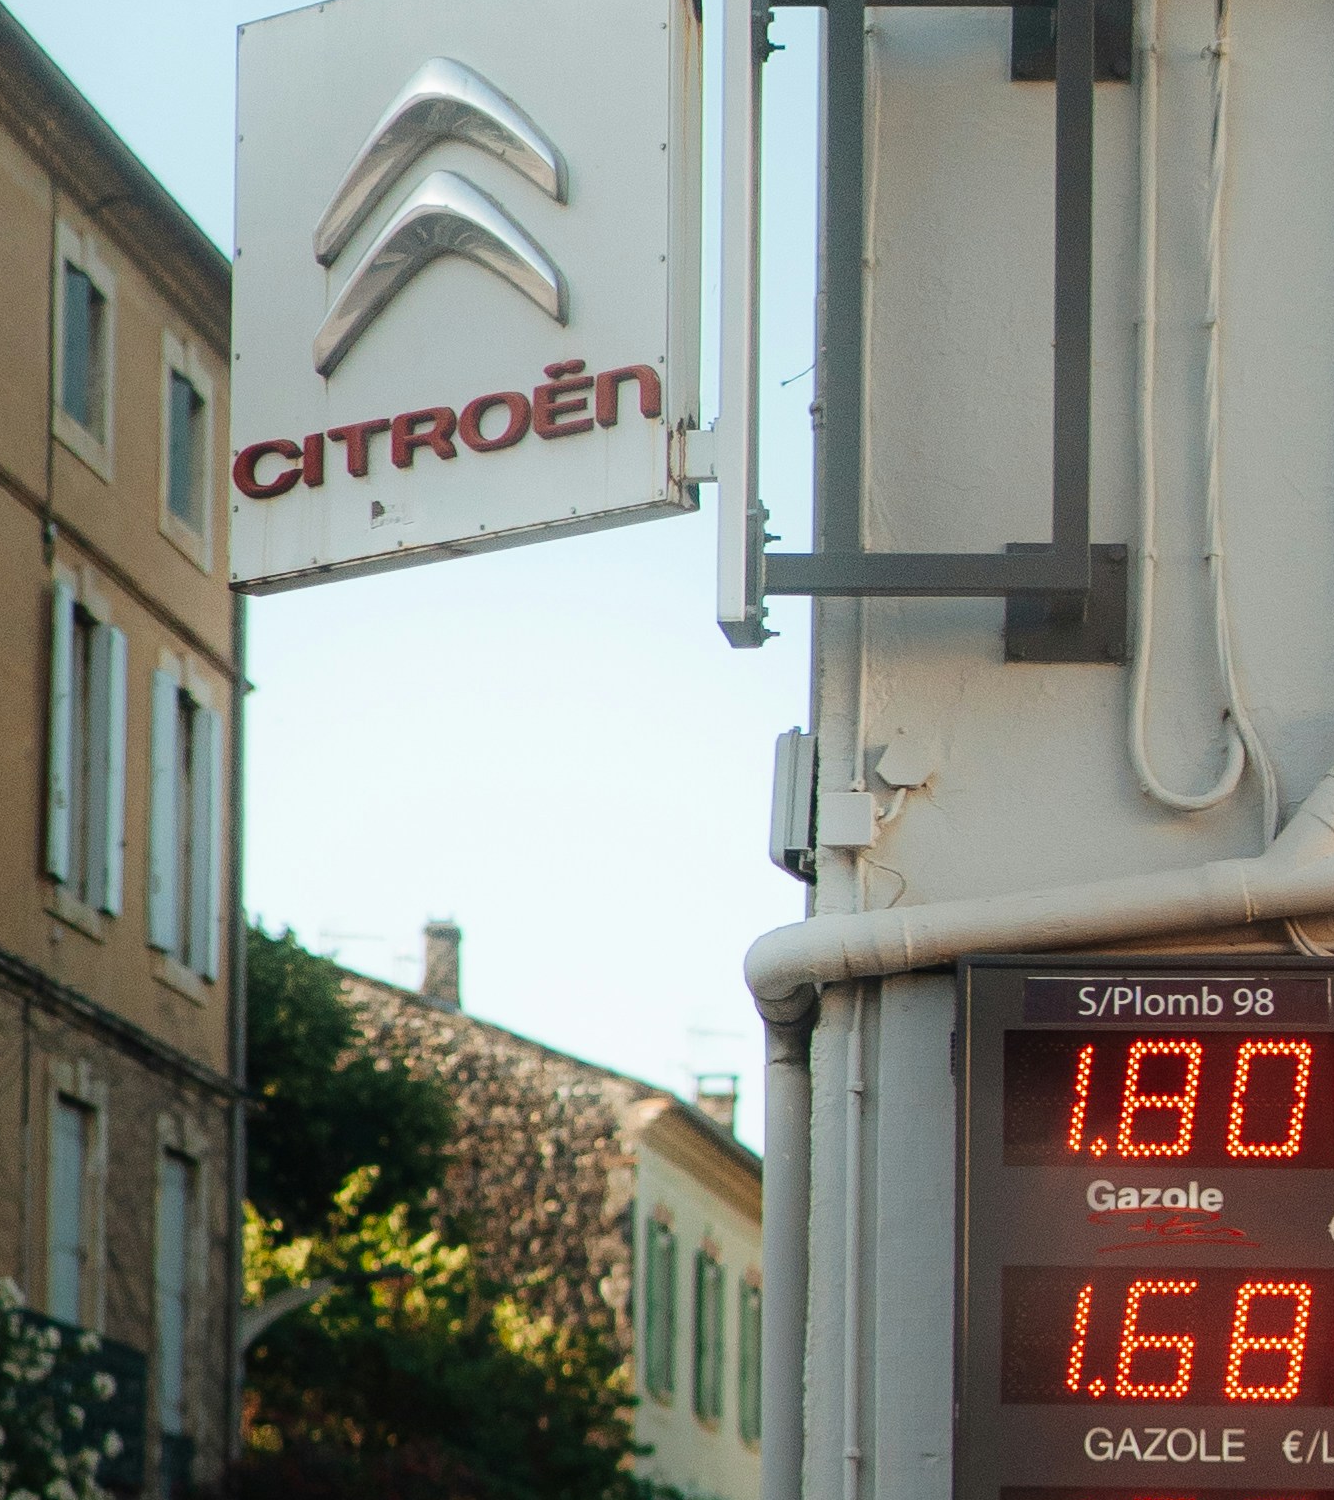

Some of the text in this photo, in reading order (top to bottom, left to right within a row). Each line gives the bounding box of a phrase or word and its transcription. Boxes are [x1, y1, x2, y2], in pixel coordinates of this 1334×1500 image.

[1078, 986, 1223, 1017] S/Plomb
[1234, 988, 1275, 1016] 98
[1087, 1180, 1224, 1212] Gazole
[1084, 1427, 1246, 1462] GAZOLE
